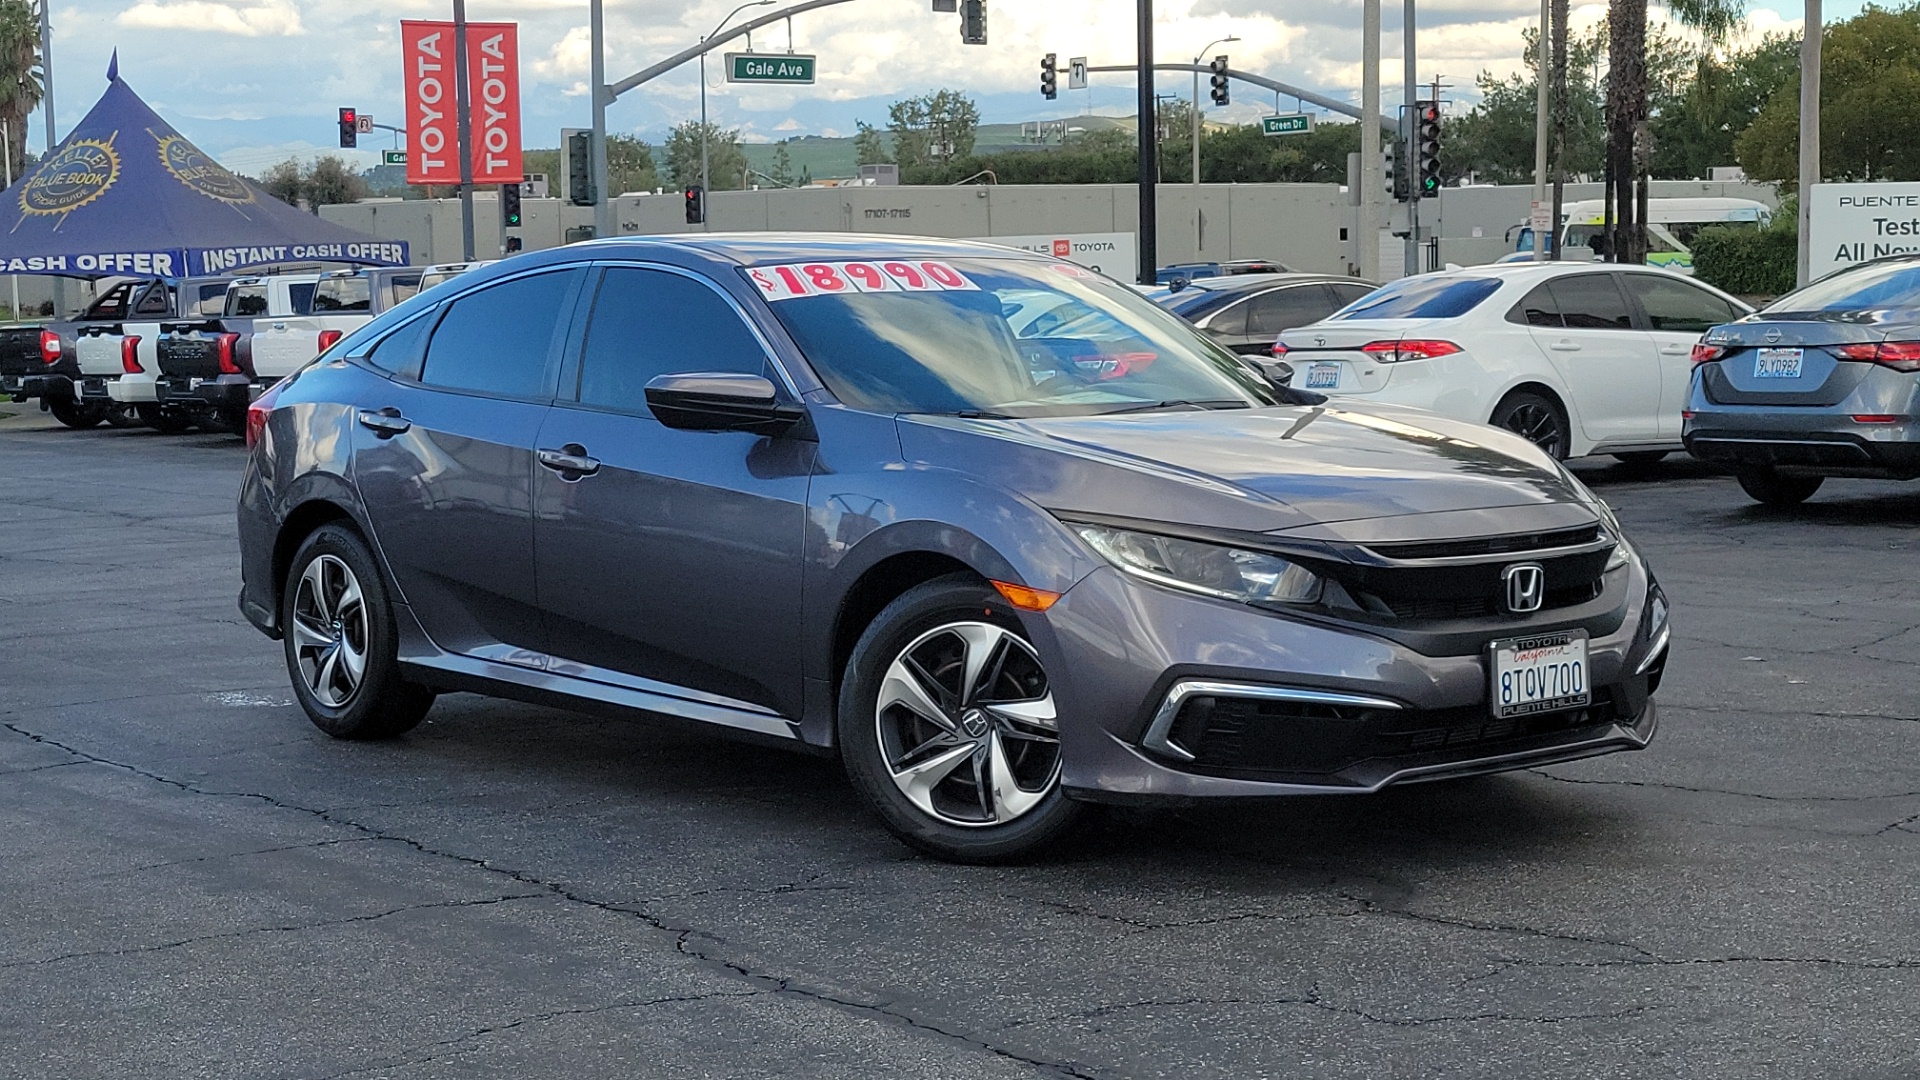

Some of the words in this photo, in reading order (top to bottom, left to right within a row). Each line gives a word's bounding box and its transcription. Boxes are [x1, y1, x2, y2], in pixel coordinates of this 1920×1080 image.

[746, 61, 774, 76] Gale
[777, 62, 803, 76] Ave
[417, 31, 446, 175] TOYOTA
[481, 33, 509, 175] TOYOTA
[1269, 121, 1292, 131] Green
[1292, 119, 1303, 129] Dr
[50, 148, 108, 171] KELLEY
[392, 153, 407, 162] Gal
[31, 172, 68, 189] BLUE
[65, 172, 107, 186] BOOK
[1839, 195, 1919, 207] PUENTE
[1872, 218, 1920, 236] Test
[1073, 242, 1115, 252] TOYOTA
[1834, 242, 1865, 261] All
[76, 253, 173, 277] OFFER
[202, 246, 287, 273] INSTANT
[292, 244, 343, 259] CASH
[347, 243, 404, 266] OFFER
[1519, 636, 1567, 649] TOYOTA
[1513, 646, 1570, 664] California
[1501, 661, 1582, 704] 8TQV700
[1502, 702, 1551, 716] PUENTE
[1551, 694, 1586, 708] HILLS
